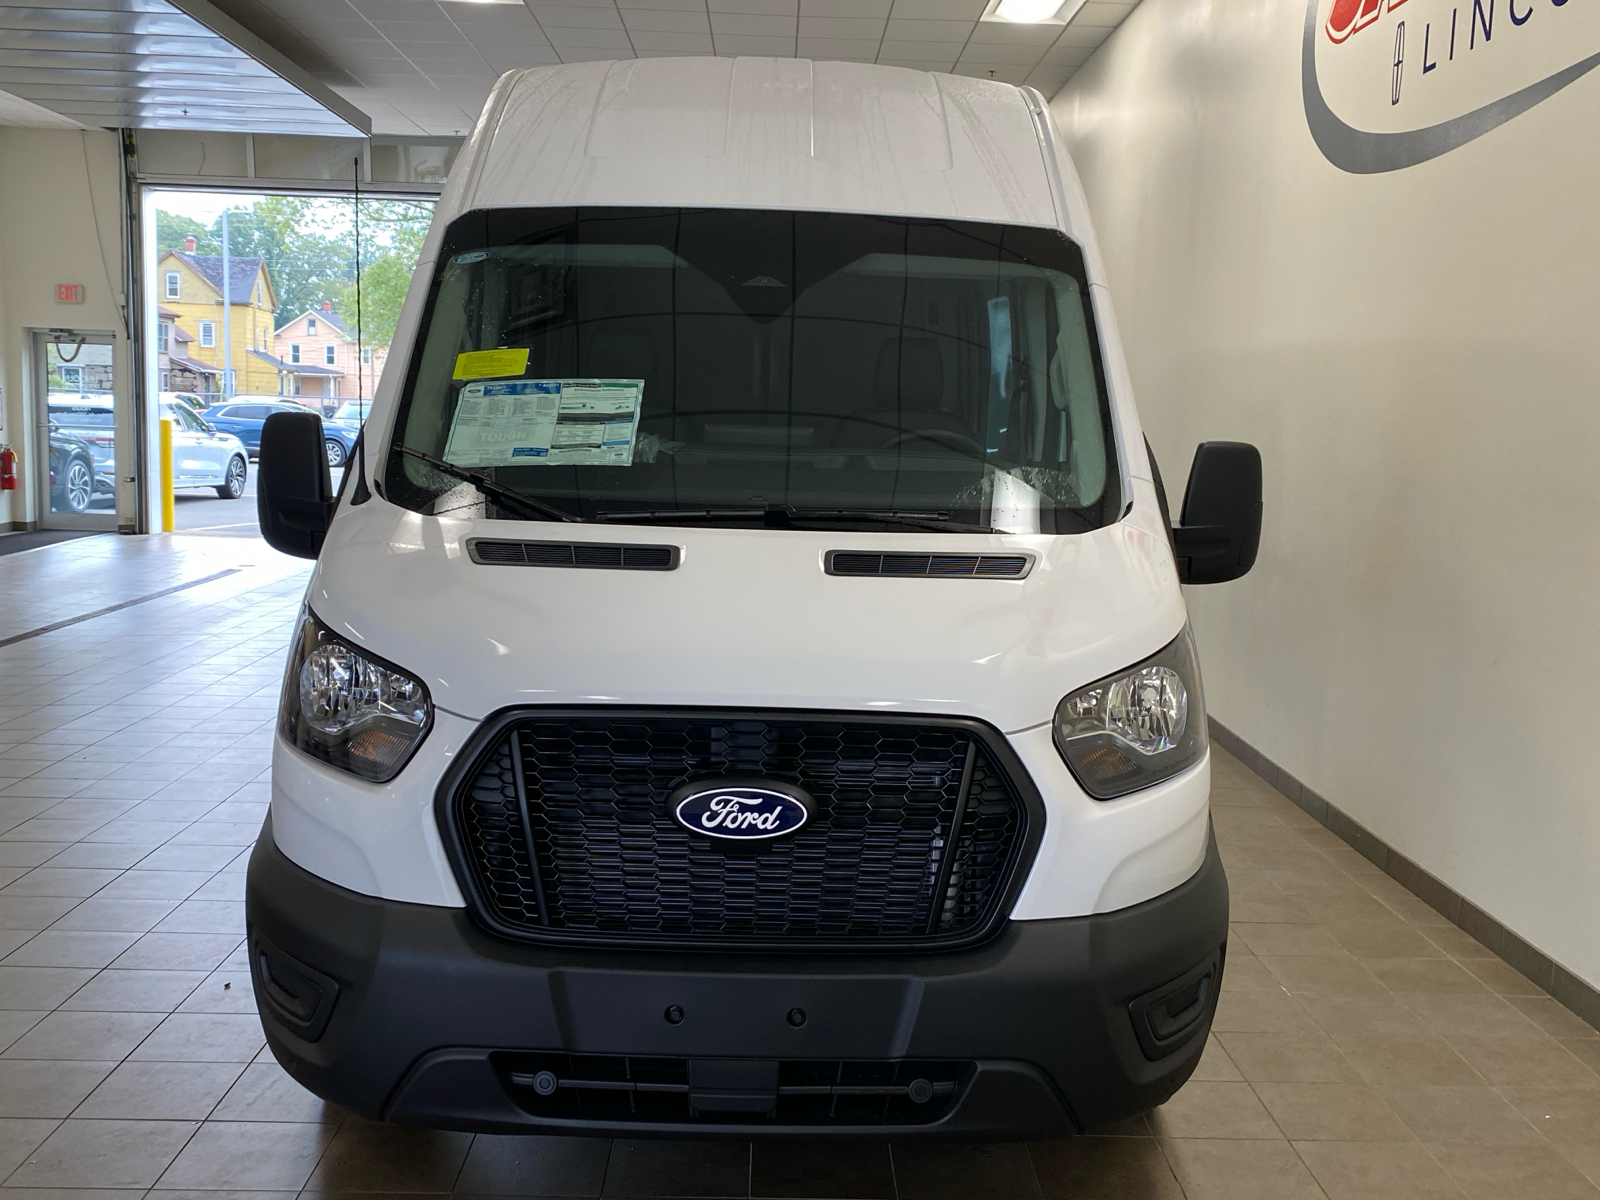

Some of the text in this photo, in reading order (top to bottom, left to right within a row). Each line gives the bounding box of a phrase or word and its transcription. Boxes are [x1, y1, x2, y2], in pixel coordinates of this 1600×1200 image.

[1422, 0, 1569, 75] LIN
[58, 284, 78, 301] EXIT
[479, 430, 527, 442] TOUGH
[701, 795, 783, 830] Ford
